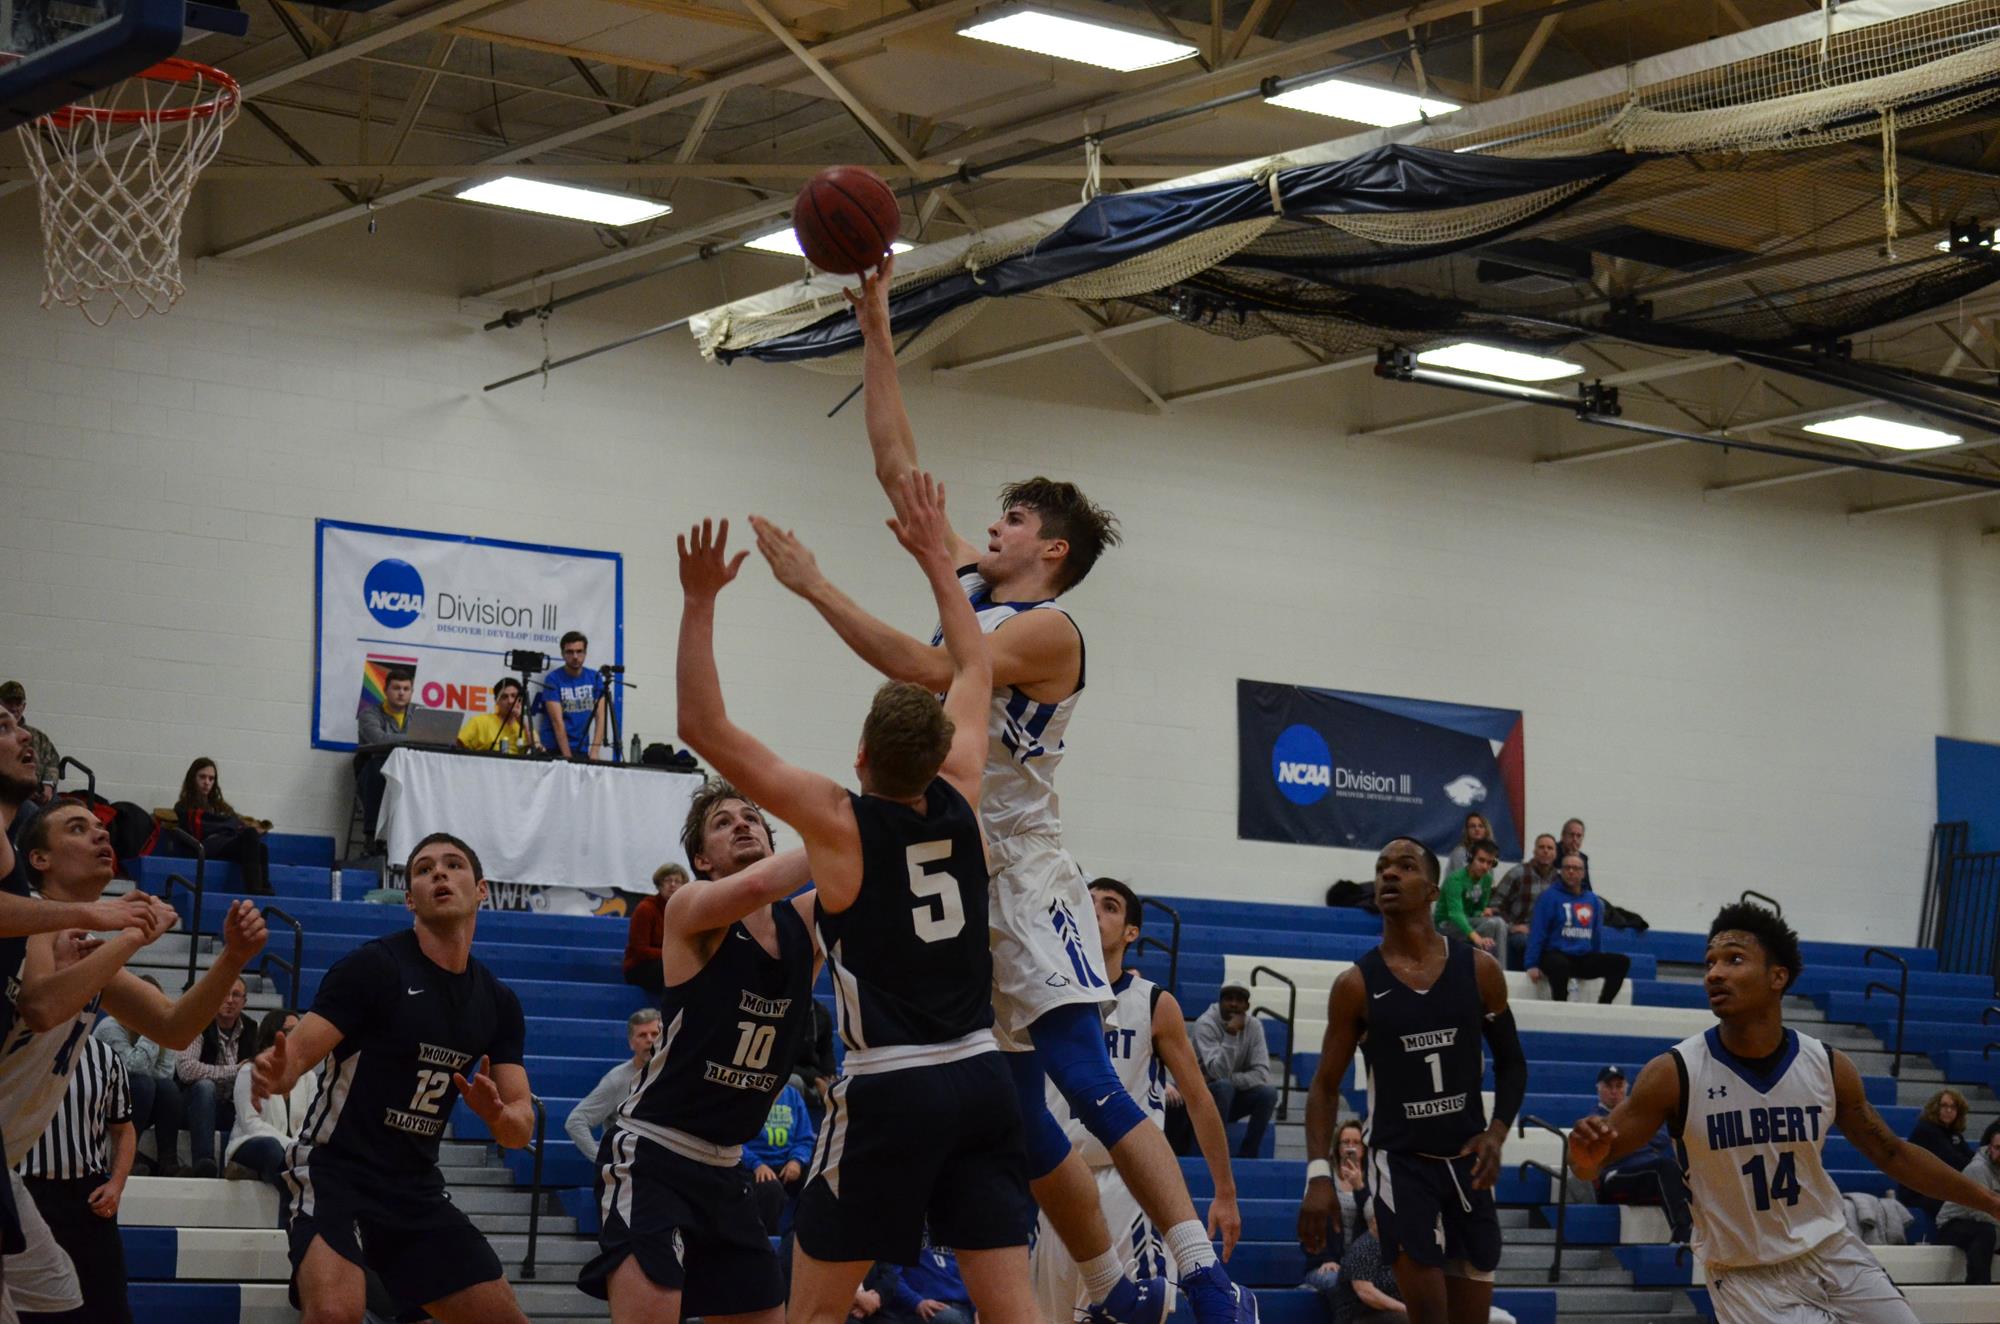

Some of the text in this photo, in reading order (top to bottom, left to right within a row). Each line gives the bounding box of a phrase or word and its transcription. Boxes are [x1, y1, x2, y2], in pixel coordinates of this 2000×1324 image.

[369, 590, 422, 613] NCAA
[437, 592, 557, 630] Division III
[437, 623, 560, 643] DISCOVER DEVELOP DEDIC
[422, 681, 487, 712] ONE
[1278, 761, 1330, 787] NCAA
[1336, 767, 1411, 794] Division III
[905, 838, 966, 943] 5
[732, 1021, 776, 1069] 10
[1104, 1028, 1137, 1059] RT
[1406, 1031, 1454, 1049] MOUNT
[421, 1045, 468, 1067] MOUNT
[1424, 1052, 1444, 1093] 1
[409, 1069, 451, 1114] 12
[1706, 1105, 1822, 1151] HILBERT
[1741, 1151, 1801, 1211] 14
